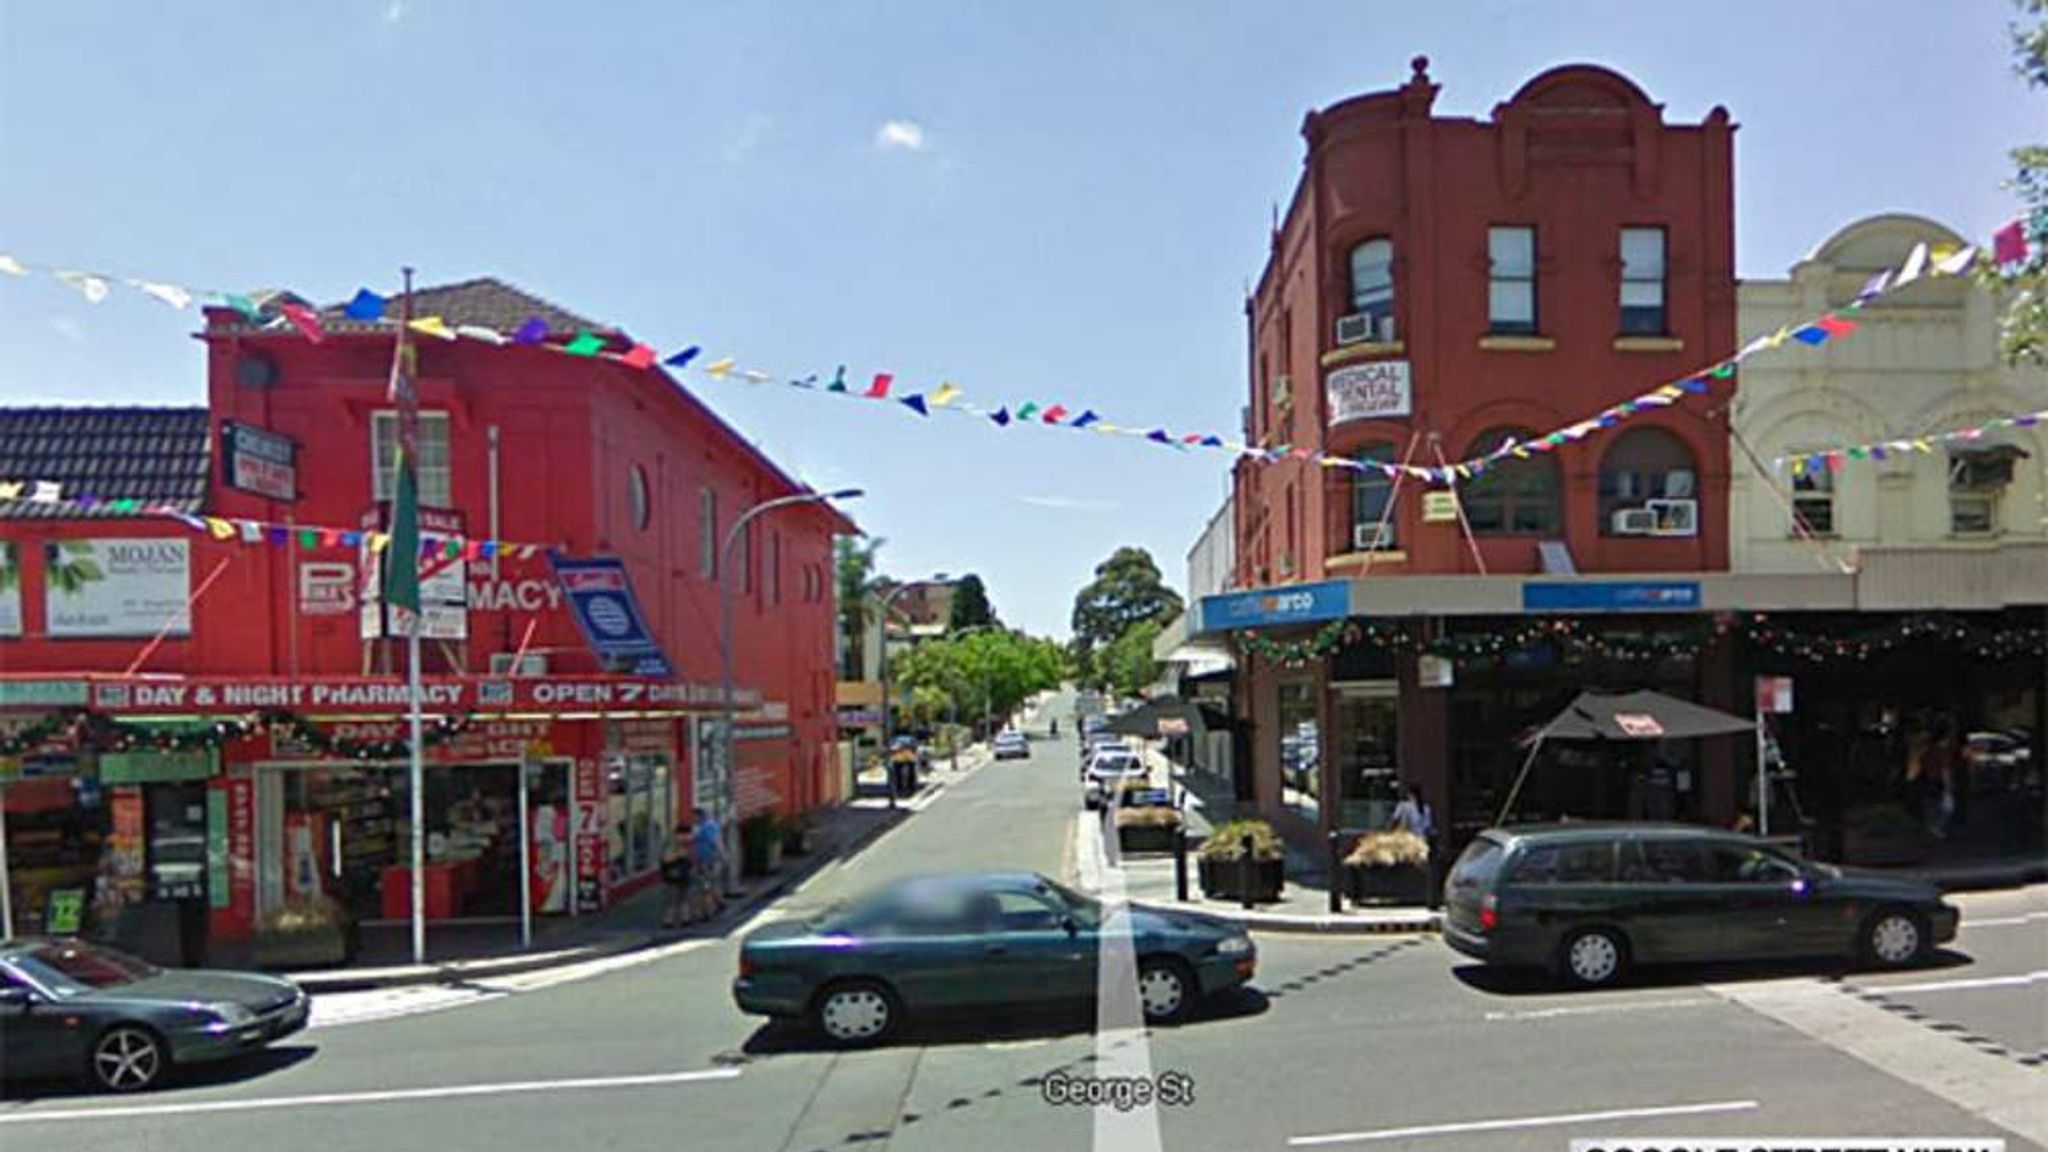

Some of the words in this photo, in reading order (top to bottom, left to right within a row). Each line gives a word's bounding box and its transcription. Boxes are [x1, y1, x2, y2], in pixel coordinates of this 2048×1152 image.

[136, 684, 186, 706] DAY
[195, 684, 215, 705] &
[224, 684, 304, 705] NIGHT
[533, 683, 612, 703] OPEN
[617, 683, 645, 702] 7
